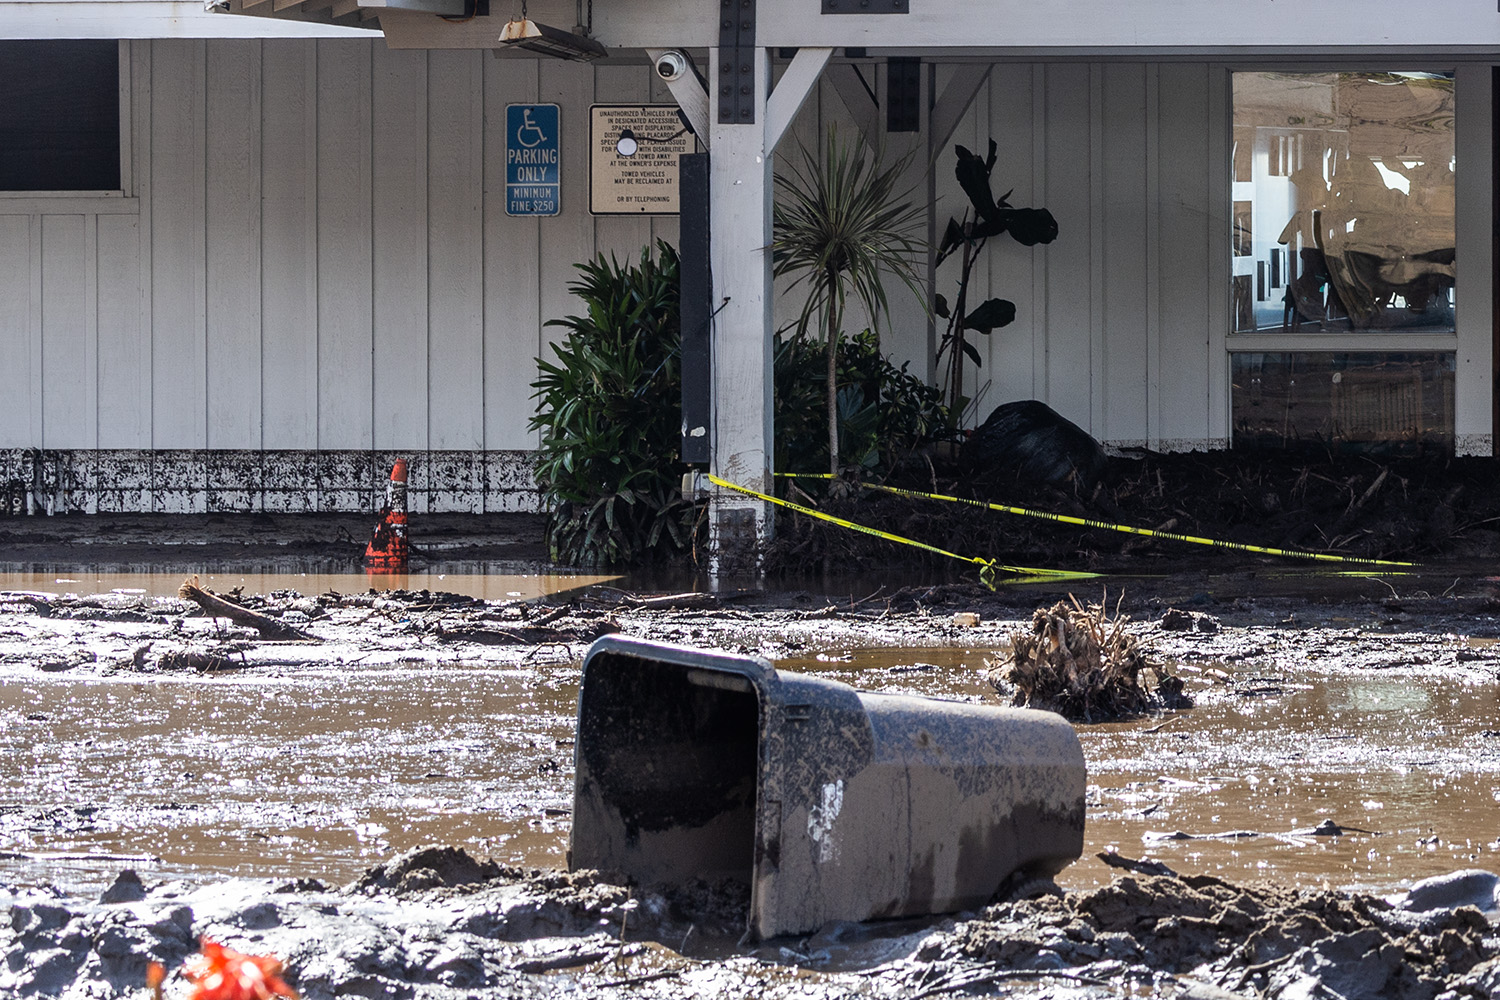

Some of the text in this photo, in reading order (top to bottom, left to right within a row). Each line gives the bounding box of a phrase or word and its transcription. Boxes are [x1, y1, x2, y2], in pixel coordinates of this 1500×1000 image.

[508, 149, 557, 164] PARKING
[517, 166, 548, 182] ONLY
[513, 187, 551, 198] MINIMUM
[511, 200, 554, 212] FINE $250
